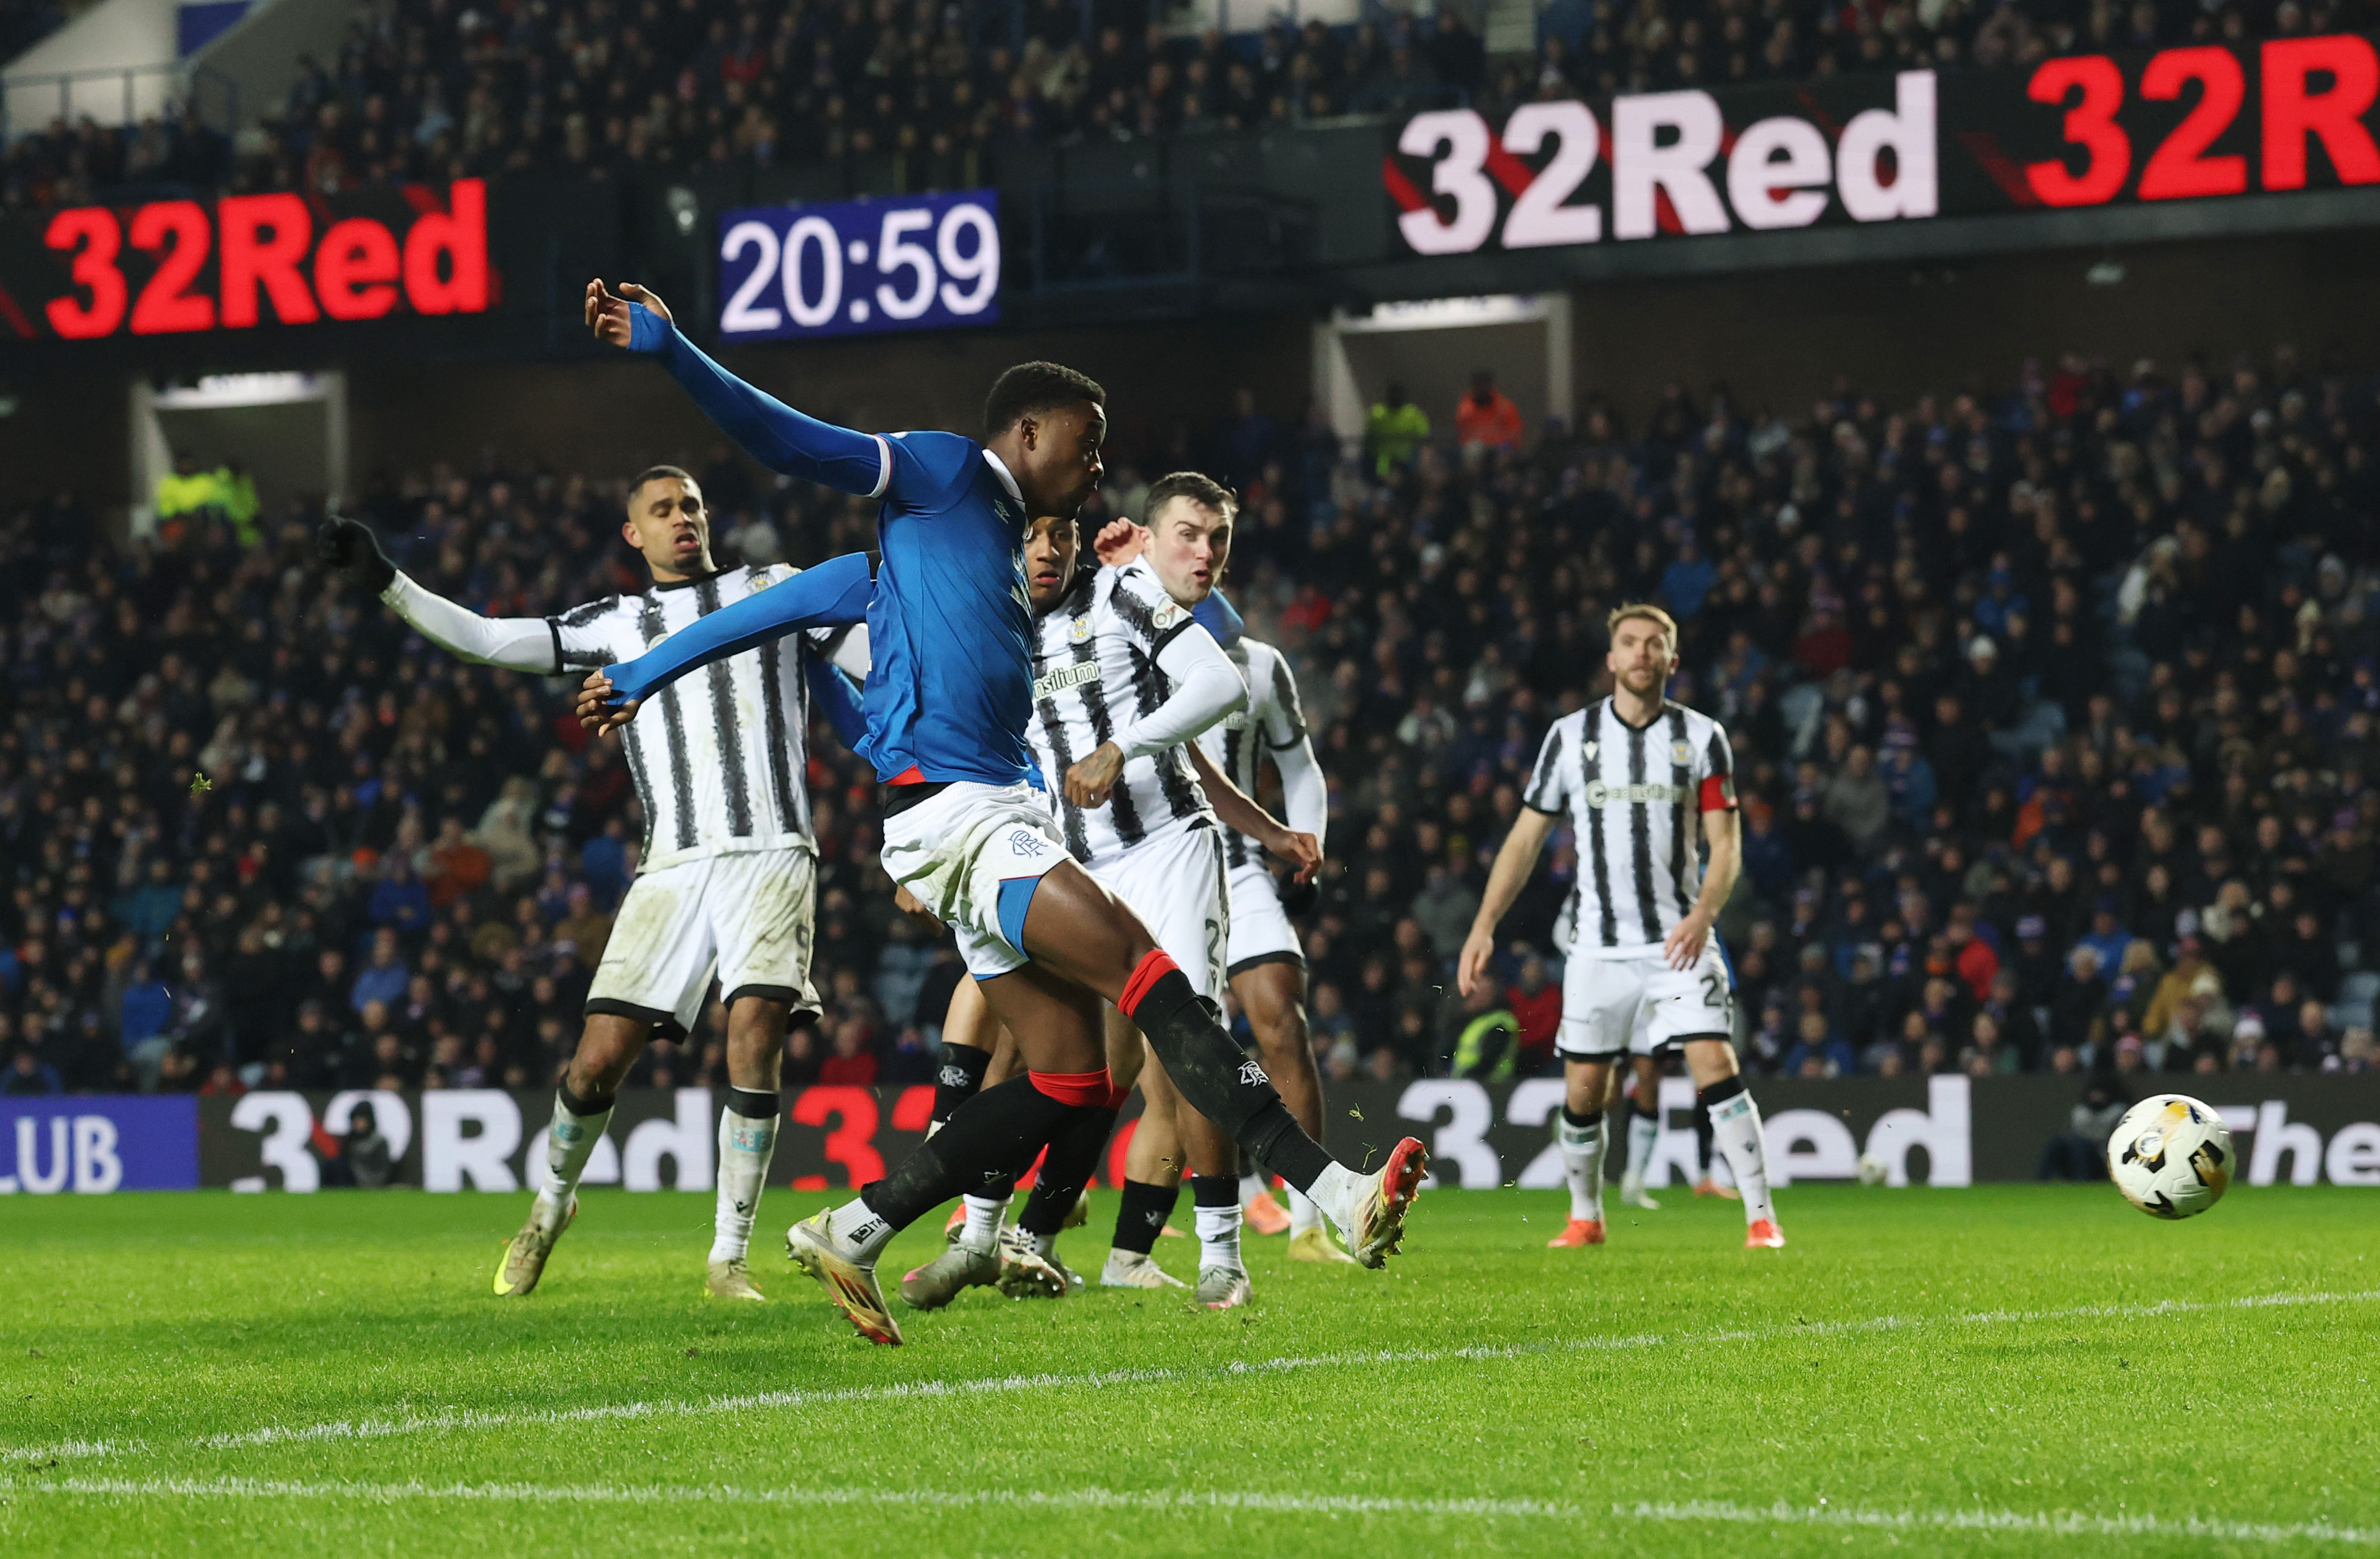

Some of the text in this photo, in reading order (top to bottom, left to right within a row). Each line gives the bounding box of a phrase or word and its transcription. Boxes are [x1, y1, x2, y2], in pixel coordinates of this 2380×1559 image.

[1398, 68, 1939, 256] 32Red
[2026, 34, 2380, 207] 32R
[44, 177, 489, 340] 32Red
[720, 203, 1000, 333] 20:59
[1033, 663, 1098, 699] nsilium
[2212, 1099, 2380, 1187] he
